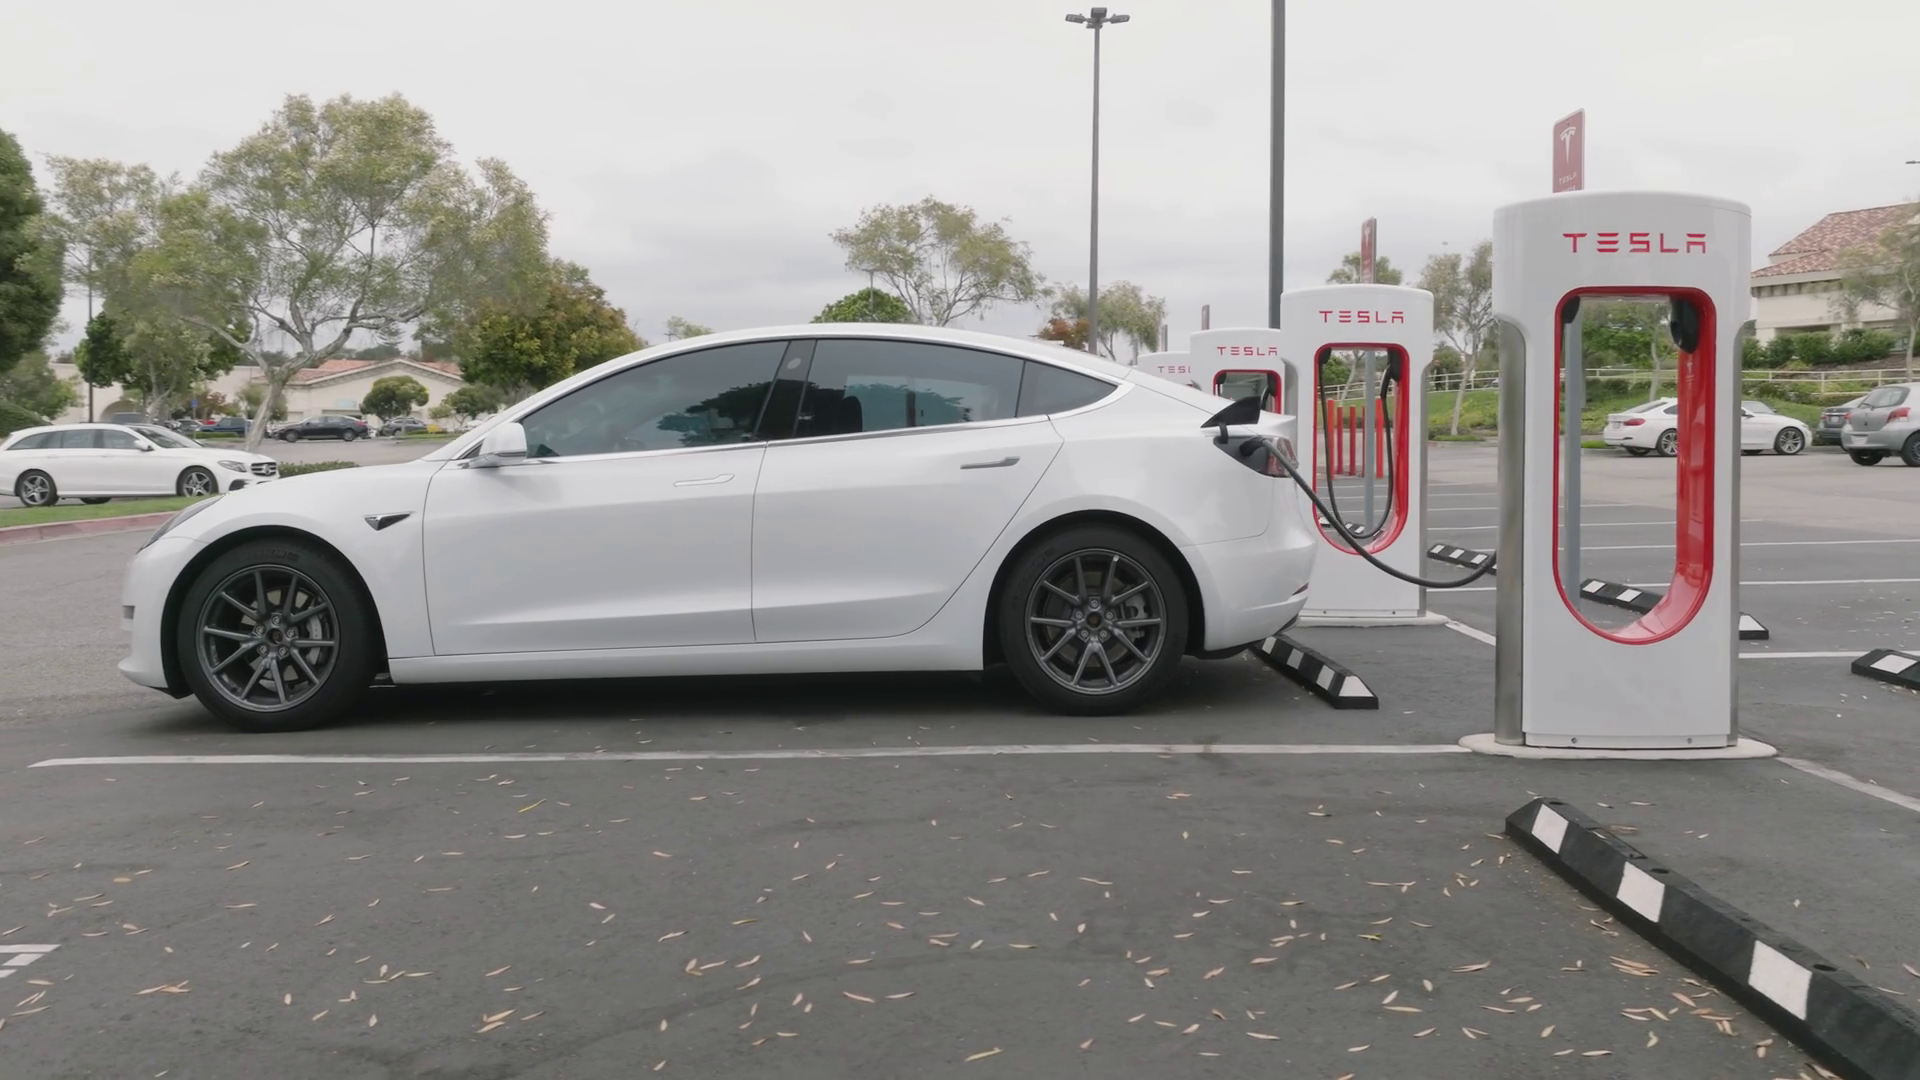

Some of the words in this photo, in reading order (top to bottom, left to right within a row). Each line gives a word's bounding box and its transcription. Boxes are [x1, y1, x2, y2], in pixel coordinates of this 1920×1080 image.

[1562, 232, 1707, 254] TESLA
[1318, 310, 1405, 324] TESLA
[1216, 346, 1278, 356] TESLA
[1157, 365, 1191, 374] TES
